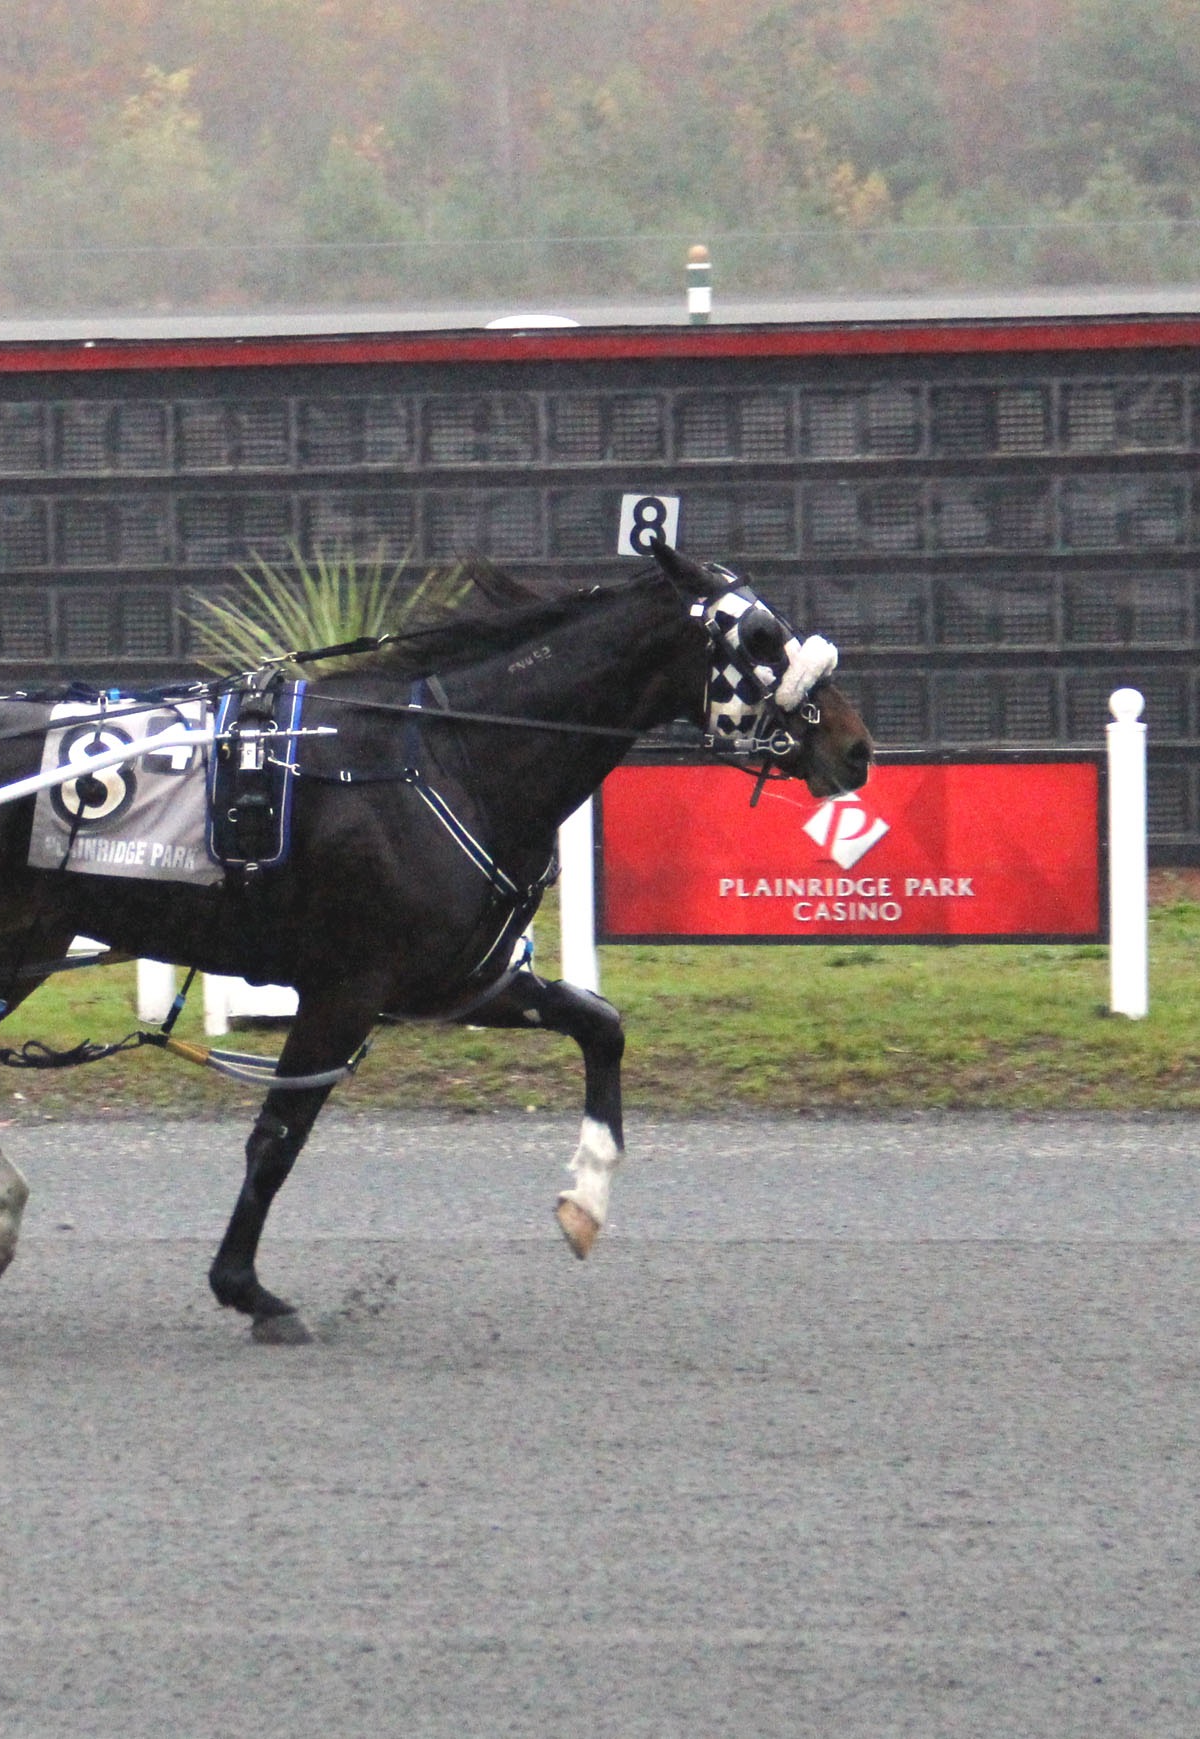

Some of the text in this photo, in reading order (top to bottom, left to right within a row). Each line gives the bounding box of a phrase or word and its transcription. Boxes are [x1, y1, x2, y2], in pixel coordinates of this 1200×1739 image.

[629, 496, 667, 555] 8
[56, 728, 133, 822] 8
[46, 836, 197, 869] LINRIDGE PARK
[718, 877, 975, 898] PLAINRIDGE PARK
[792, 901, 902, 922] CASINO
